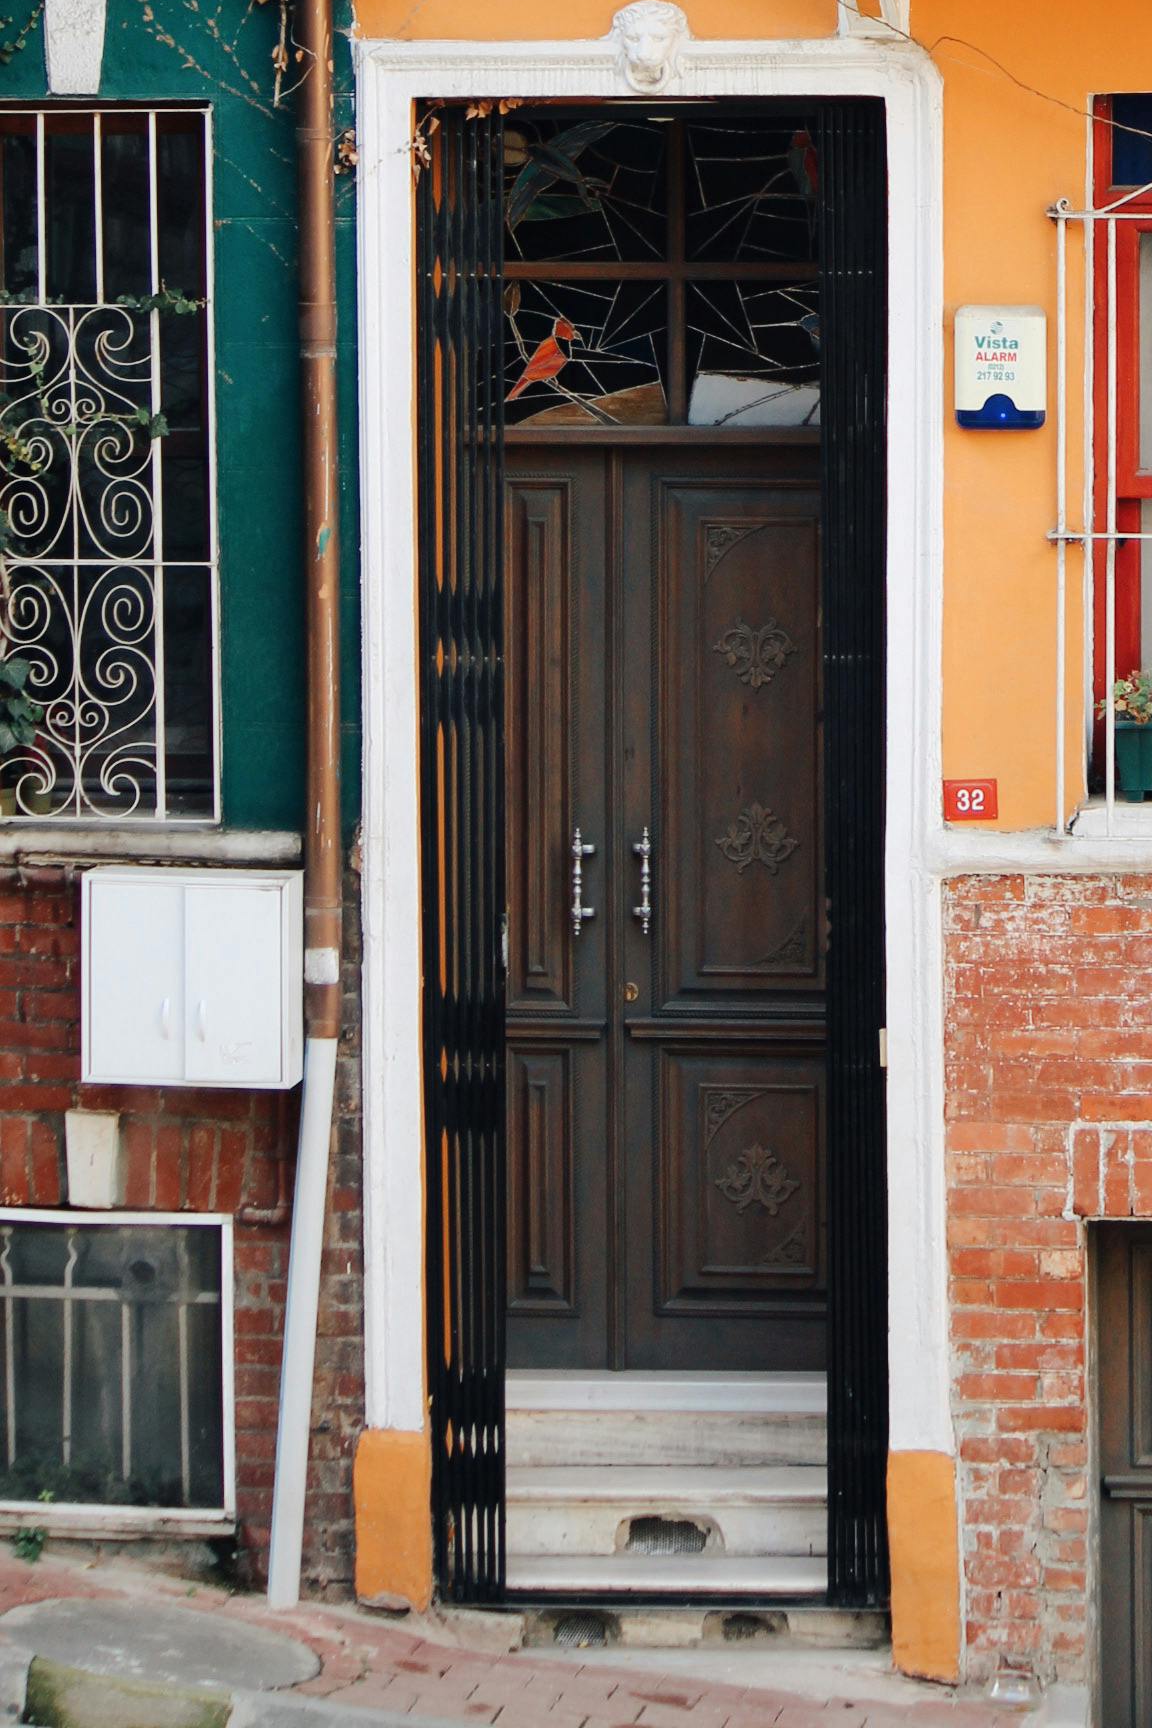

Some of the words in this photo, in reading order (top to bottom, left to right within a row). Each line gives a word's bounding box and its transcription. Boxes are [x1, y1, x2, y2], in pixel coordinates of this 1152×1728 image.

[975, 336, 1018, 349] Vista
[976, 352, 1016, 361] ALARM
[957, 789, 984, 811] 32
